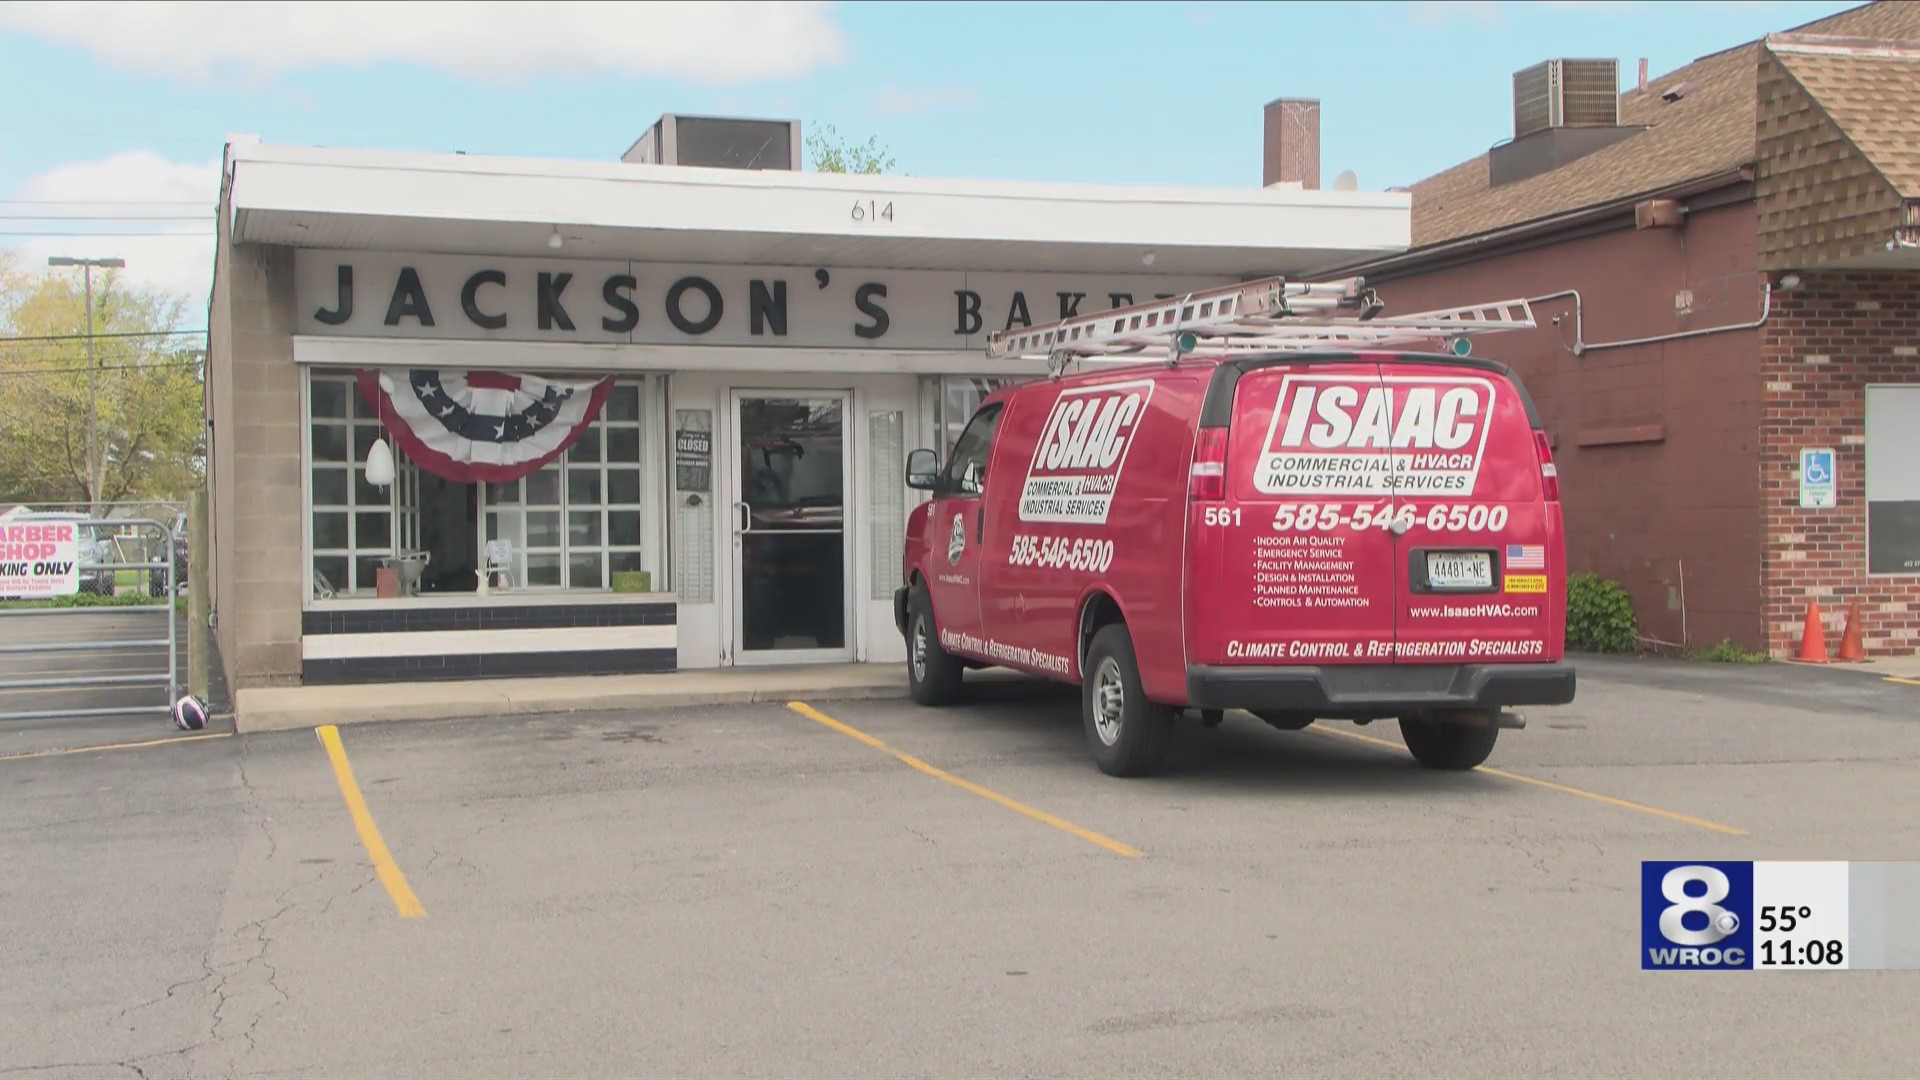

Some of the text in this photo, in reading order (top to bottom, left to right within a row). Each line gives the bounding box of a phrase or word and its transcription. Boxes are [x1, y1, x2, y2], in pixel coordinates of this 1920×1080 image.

[851, 200, 894, 222] 614
[314, 264, 890, 339] JACKSON'S
[1280, 386, 1479, 449] ISAAC
[1036, 393, 1141, 470] ISAAC
[677, 438, 709, 452] CLOSED
[1270, 454, 1473, 472] COMMERCIAL & HVACR
[1027, 475, 1114, 496] COMMERCIAL & HVACR
[1267, 475, 1466, 489] INDUSTRIAL SERVICES
[1023, 500, 1105, 515] INDUSTRIAL SERVICES
[1204, 507, 1242, 526] 561
[1272, 504, 1508, 531] 585-546-6500
[1257, 536, 1345, 547] INDOOR AIR QUALITY
[1009, 535, 1114, 573] 585-546-6500
[1257, 548, 1343, 558] EMERGENCY SERVICE
[33, 561, 73, 576] ONLY
[1257, 560, 1354, 570] FACILITY MANAGEMENT
[1257, 573, 1355, 582] DESIGN & INSTALLATION
[1257, 585, 1358, 595] PLANNED MAINTENANCE
[1257, 597, 1369, 607] CONTROLS & AUTOMATION
[1410, 605, 1538, 617] www.IsaacHVAC.com
[941, 628, 961, 648] CLIMATE
[961, 632, 983, 654] CONTROL
[989, 639, 1031, 665] REFRIGERATION
[1031, 648, 1069, 674] SPECIALISTS
[1227, 639, 1543, 657] CLIMATE CONTROL & REFRIGERATION SPECIALISTS
